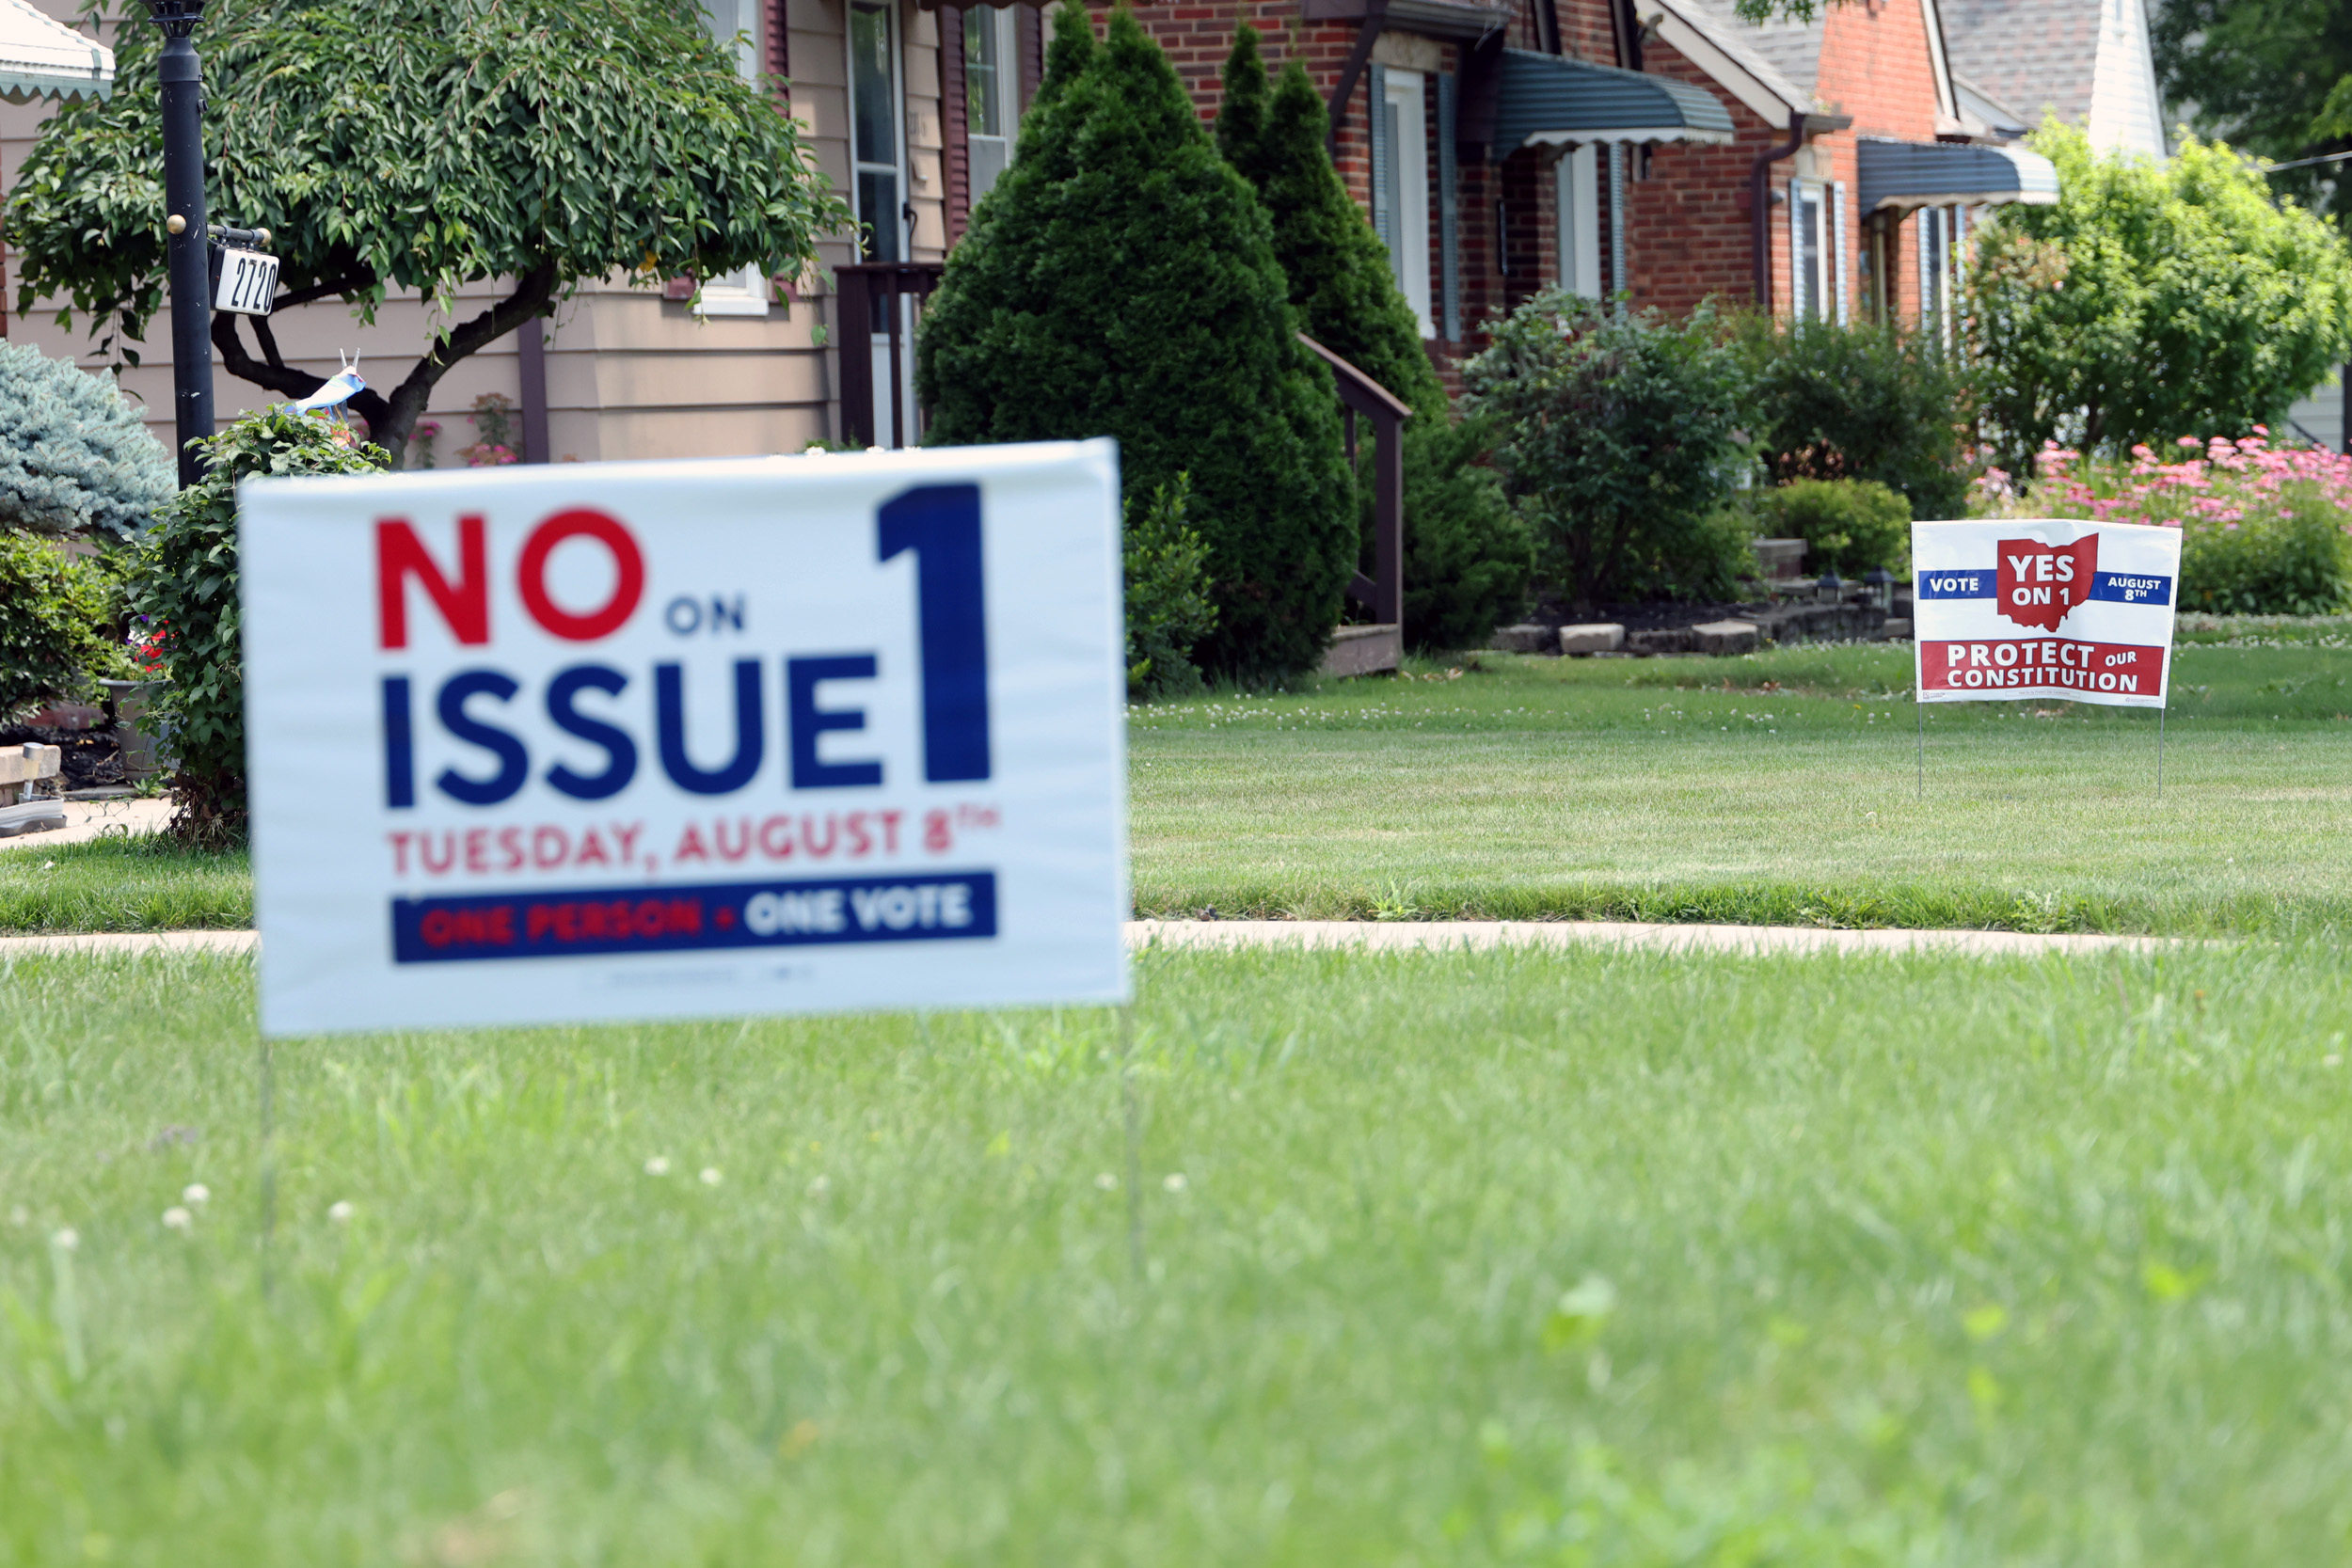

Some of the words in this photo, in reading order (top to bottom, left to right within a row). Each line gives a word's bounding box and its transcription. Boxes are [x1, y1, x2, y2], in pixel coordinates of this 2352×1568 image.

[231, 258, 277, 312] 2720
[373, 505, 645, 650] NO
[665, 594, 747, 637] ON
[2007, 554, 2075, 582] YES
[1930, 578, 1979, 593] VOTE
[2011, 587, 2052, 606] ON
[2058, 588, 2070, 606] 1
[2107, 577, 2161, 590] AUGUST
[2124, 588, 2148, 602] 8TH
[381, 649, 886, 809] ISSUE
[875, 479, 993, 784] 1
[1947, 641, 2095, 668] PROTECT
[2105, 651, 2137, 667] OUR
[1947, 666, 2138, 692] CONSTITUTION
[387, 820, 660, 878] TUESDAY,
[674, 810, 903, 864] AUGUST
[420, 907, 516, 949] ONE
[526, 898, 704, 942] PERSON
[744, 889, 845, 937] ONE
[851, 883, 974, 932] VOTE
